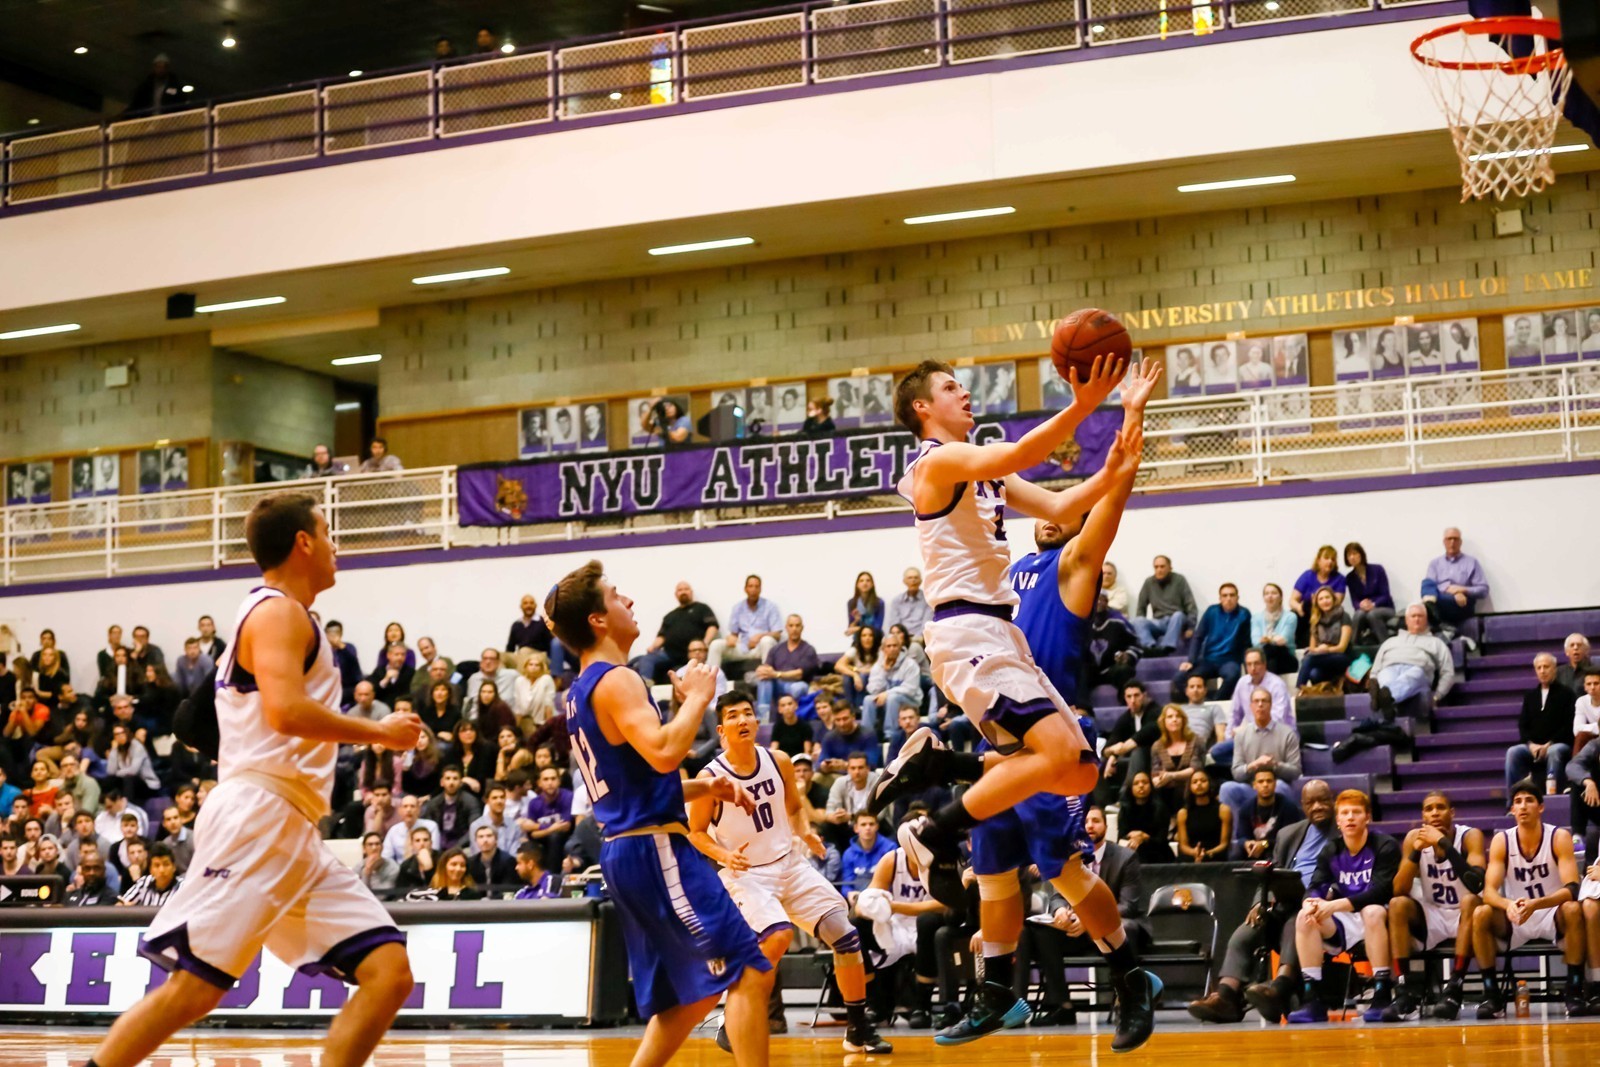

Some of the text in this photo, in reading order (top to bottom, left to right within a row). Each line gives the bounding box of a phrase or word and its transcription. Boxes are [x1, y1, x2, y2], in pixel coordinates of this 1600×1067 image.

[1120, 299, 1252, 330] NIVERSITY
[1261, 286, 1395, 317] ATHLETICS
[1405, 279, 1474, 304] HALL
[1523, 267, 1592, 293] FAME
[559, 422, 1006, 516] NYU ATHLET
[746, 778, 776, 801] YU
[752, 802, 774, 833] 10
[1339, 868, 1373, 885] NYU
[1428, 864, 1459, 882] NYU
[1514, 863, 1550, 882] NYU
[901, 884, 927, 898] NY
[1432, 883, 1459, 905] 20
[1525, 883, 1546, 899] 11
